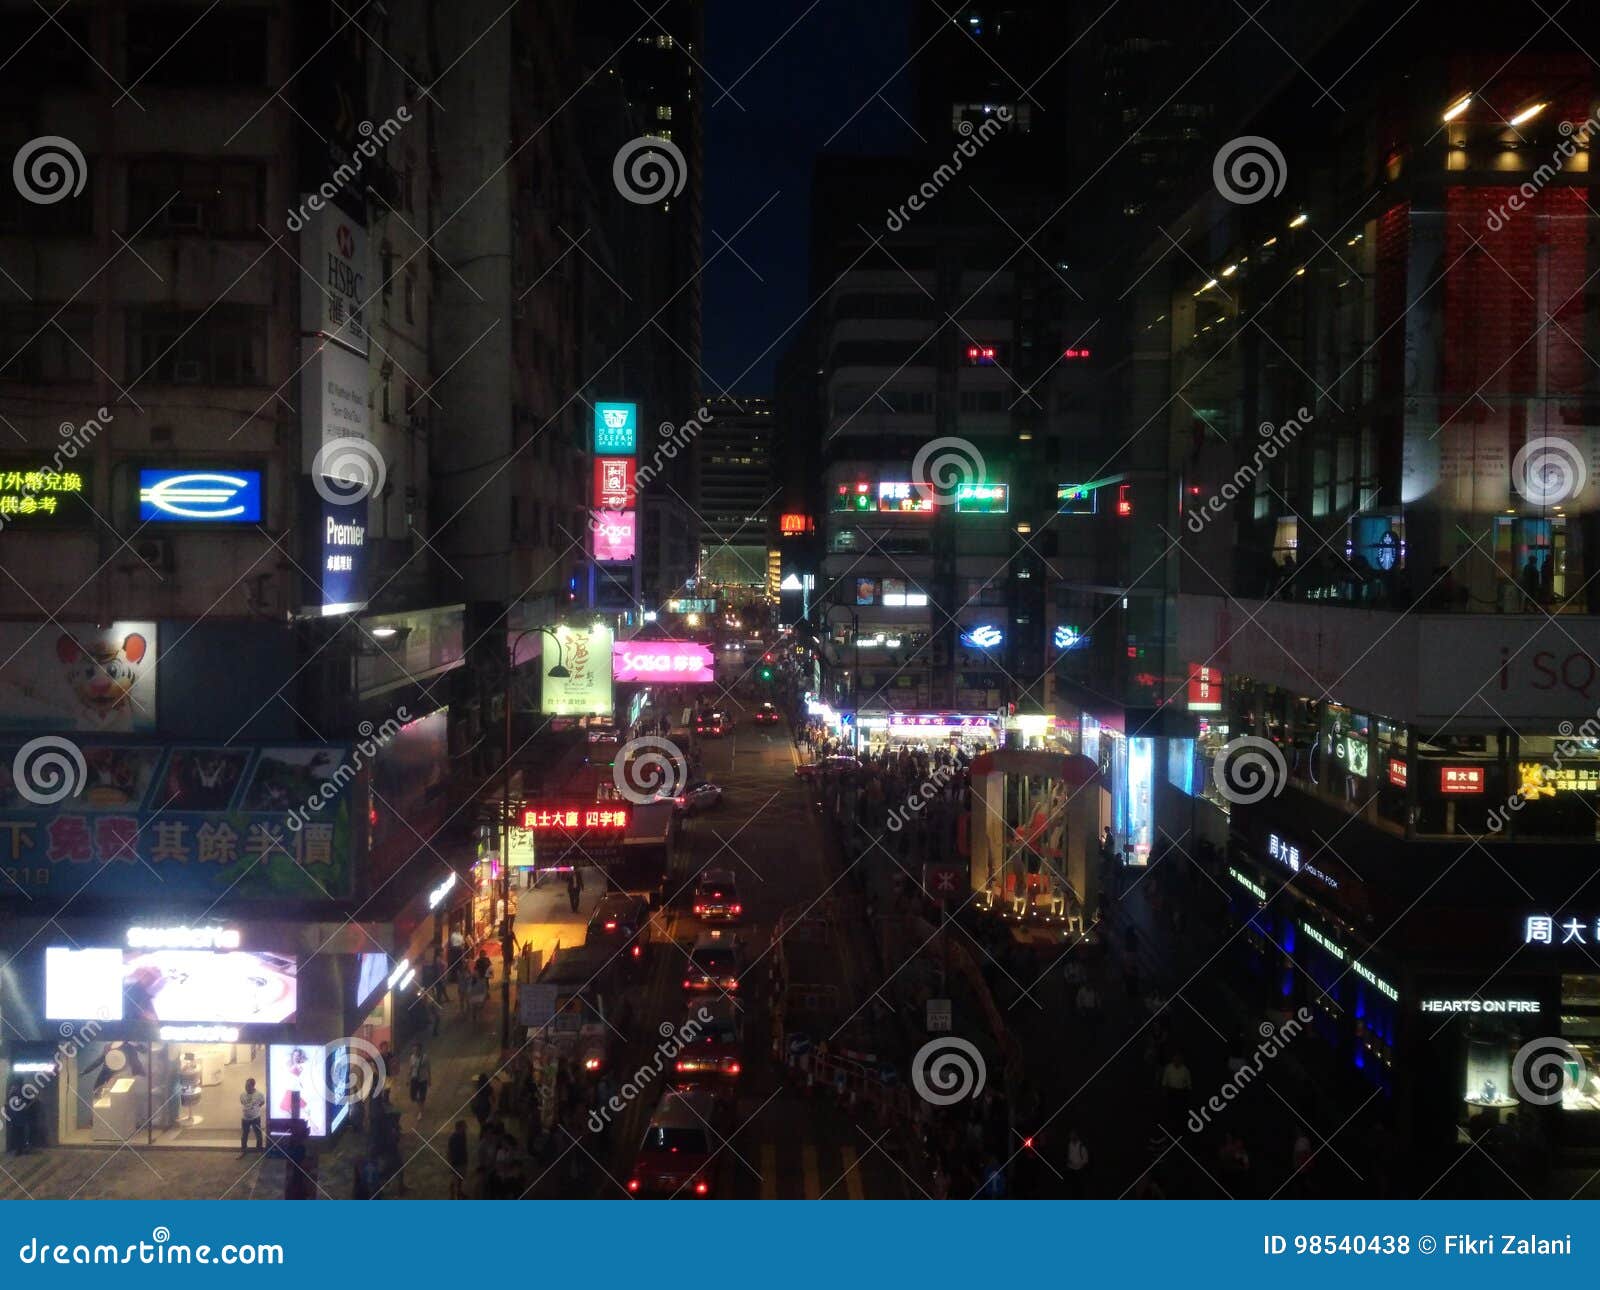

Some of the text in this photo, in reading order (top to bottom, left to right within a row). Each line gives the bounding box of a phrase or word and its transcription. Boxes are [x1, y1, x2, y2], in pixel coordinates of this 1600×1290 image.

[328, 252, 363, 305] HSBC
[0, 472, 82, 492] 外幣兌換
[327, 516, 365, 546] Premier
[1270, 833, 1299, 872] 周大福
[1526, 916, 1600, 944] 周大
[1353, 960, 1376, 985] FRANCK
[1421, 1000, 1541, 1013] HEARTS ON FIRE
